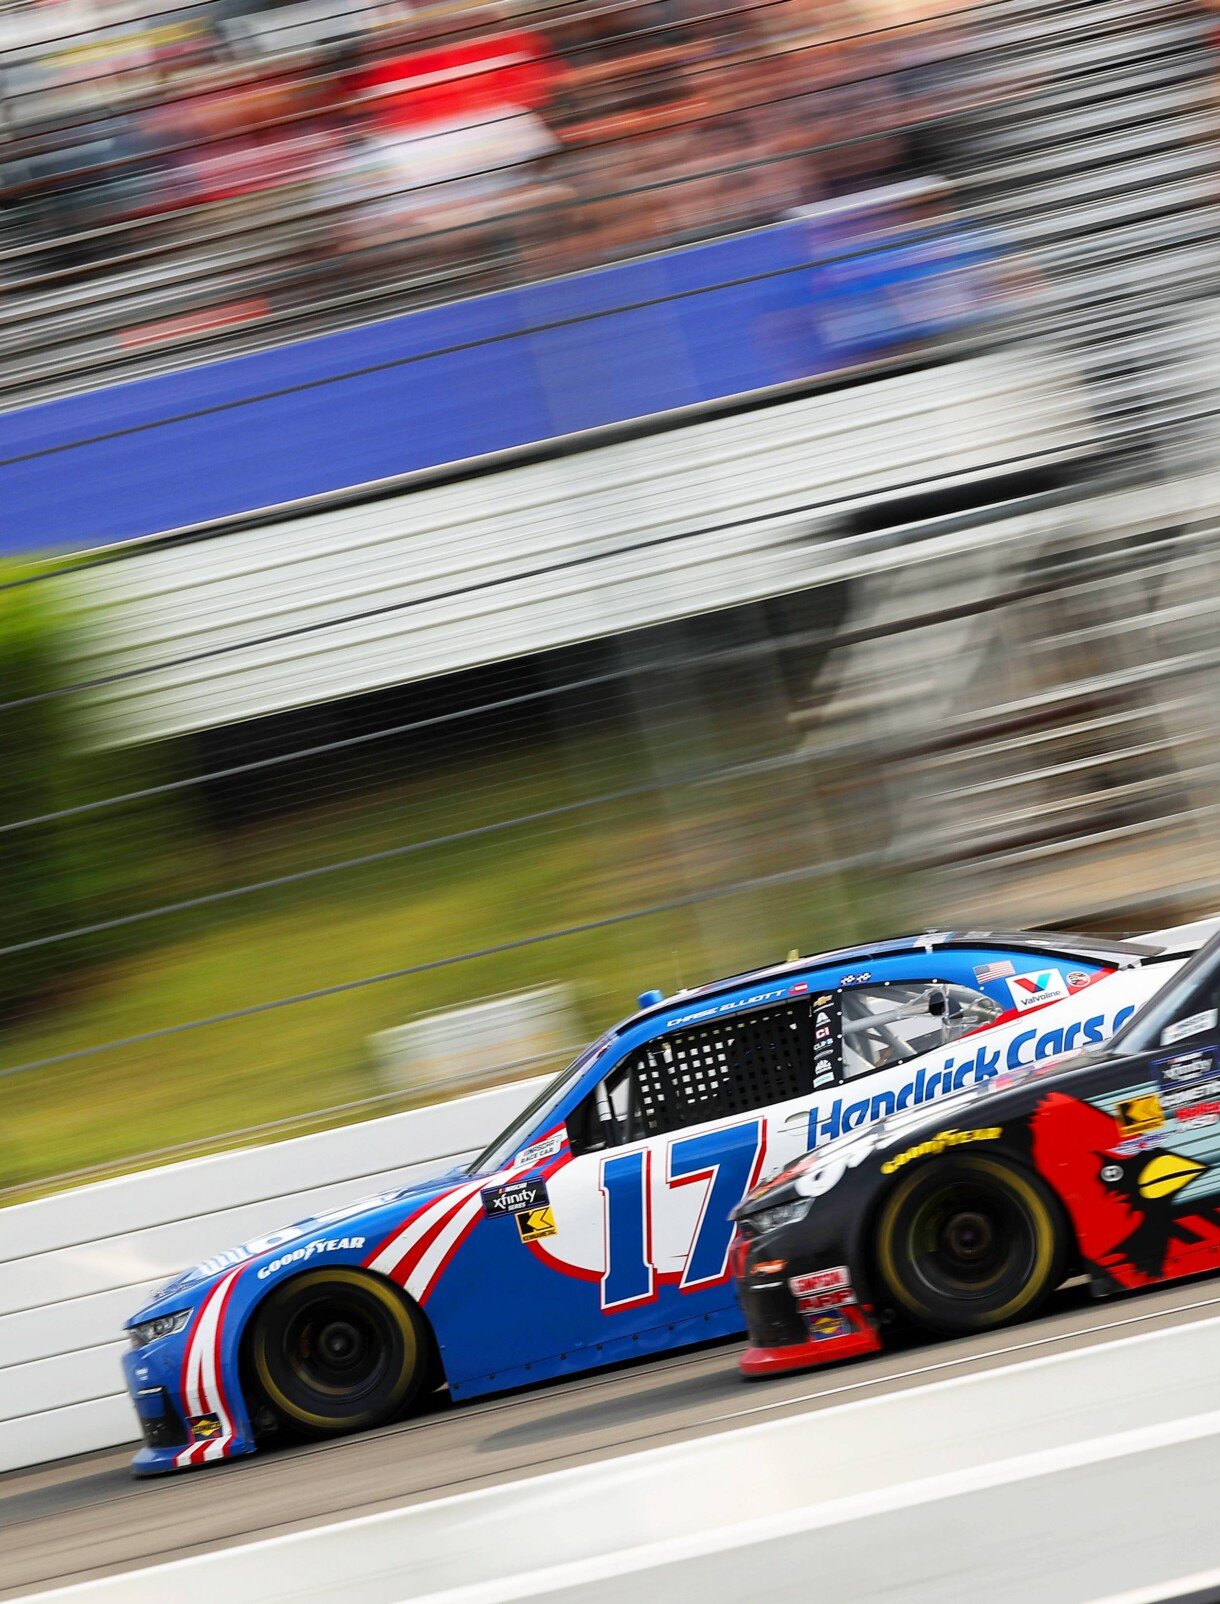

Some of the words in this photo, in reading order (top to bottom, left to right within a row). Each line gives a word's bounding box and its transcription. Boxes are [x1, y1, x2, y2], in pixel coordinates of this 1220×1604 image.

[719, 988, 787, 1012] ELLIOTT
[1020, 990, 1062, 1006] Valvoline
[880, 1126, 1004, 1175] GOODYEAR
[493, 1189, 537, 1210] xfinity
[599, 1115, 767, 1317] 17
[256, 1237, 366, 1280] GOODYEAR
